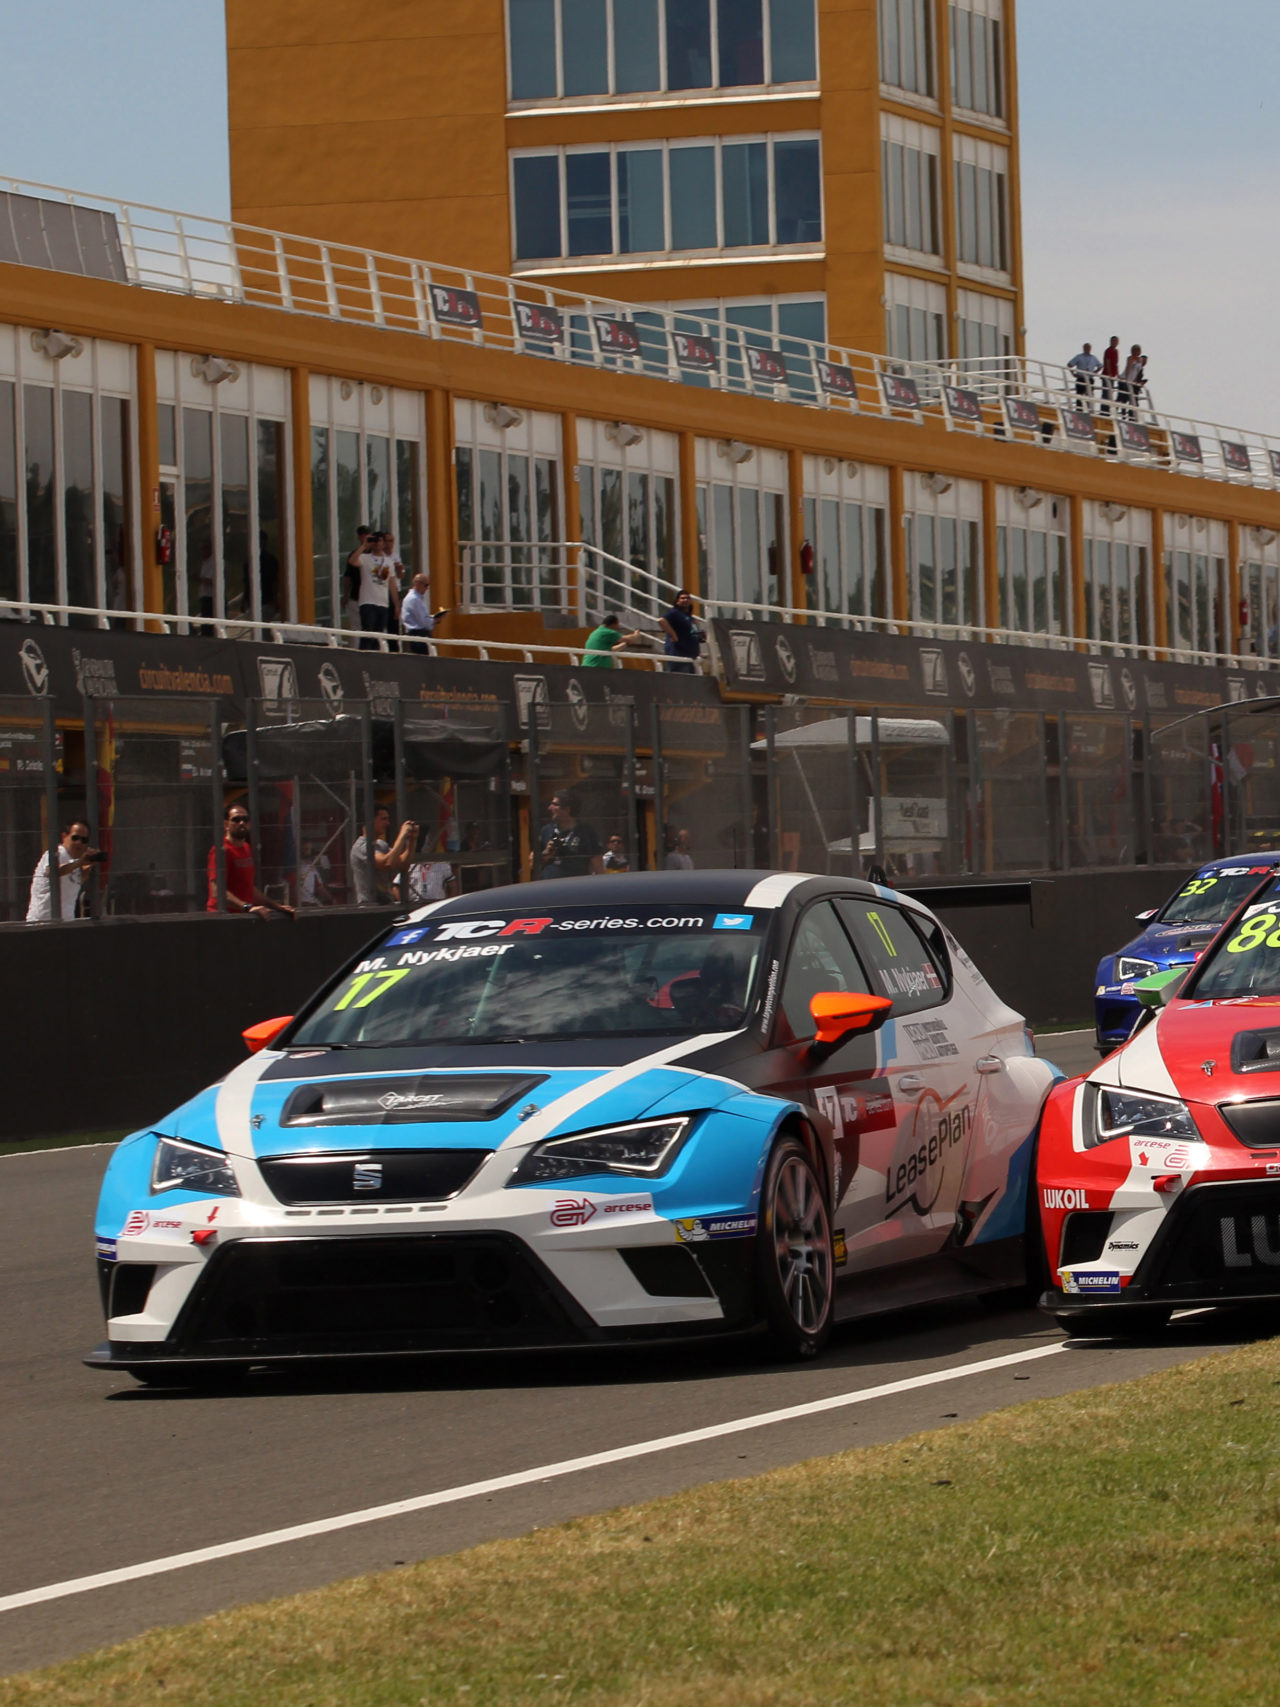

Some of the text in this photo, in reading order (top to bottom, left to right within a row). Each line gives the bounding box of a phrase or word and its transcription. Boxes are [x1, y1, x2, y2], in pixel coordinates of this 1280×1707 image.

[1179, 878, 1218, 897] 32
[866, 911, 898, 957] 17
[354, 941, 513, 974] M. Nykjaer
[333, 969, 411, 1011] 17
[886, 1104, 972, 1204] LeasePlan
[1133, 1139, 1171, 1150] arcese
[604, 1202, 652, 1214] arcese
[1043, 1188, 1089, 1210] LUKOIL
[709, 1219, 757, 1232] MICHELIN
[1078, 1276, 1120, 1286] MICHELIN
